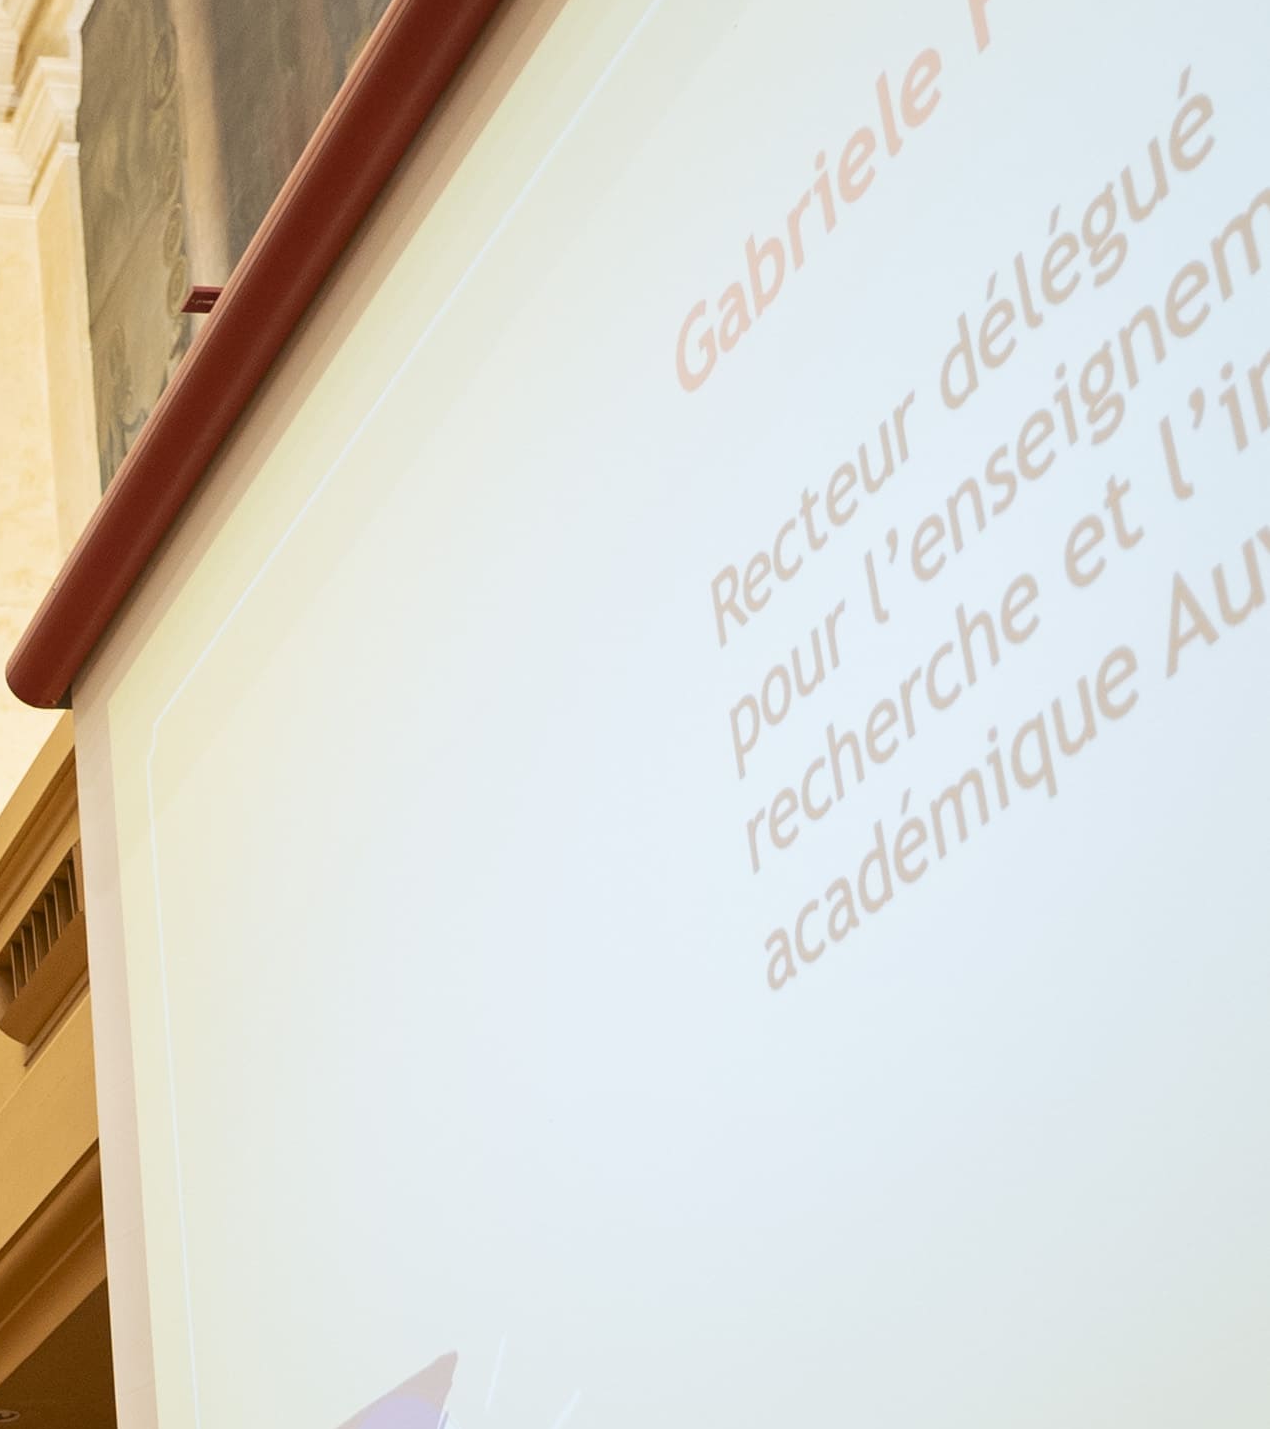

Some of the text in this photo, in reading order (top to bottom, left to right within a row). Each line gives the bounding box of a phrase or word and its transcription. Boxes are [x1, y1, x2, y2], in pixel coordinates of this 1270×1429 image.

[675, 47, 942, 393] Gabriele
[710, 63, 1216, 649] Recteur délégué
[729, 598, 846, 779] pour
[746, 573, 1041, 875] recherche
[1064, 474, 1145, 589] et
[764, 644, 1141, 992] académique
